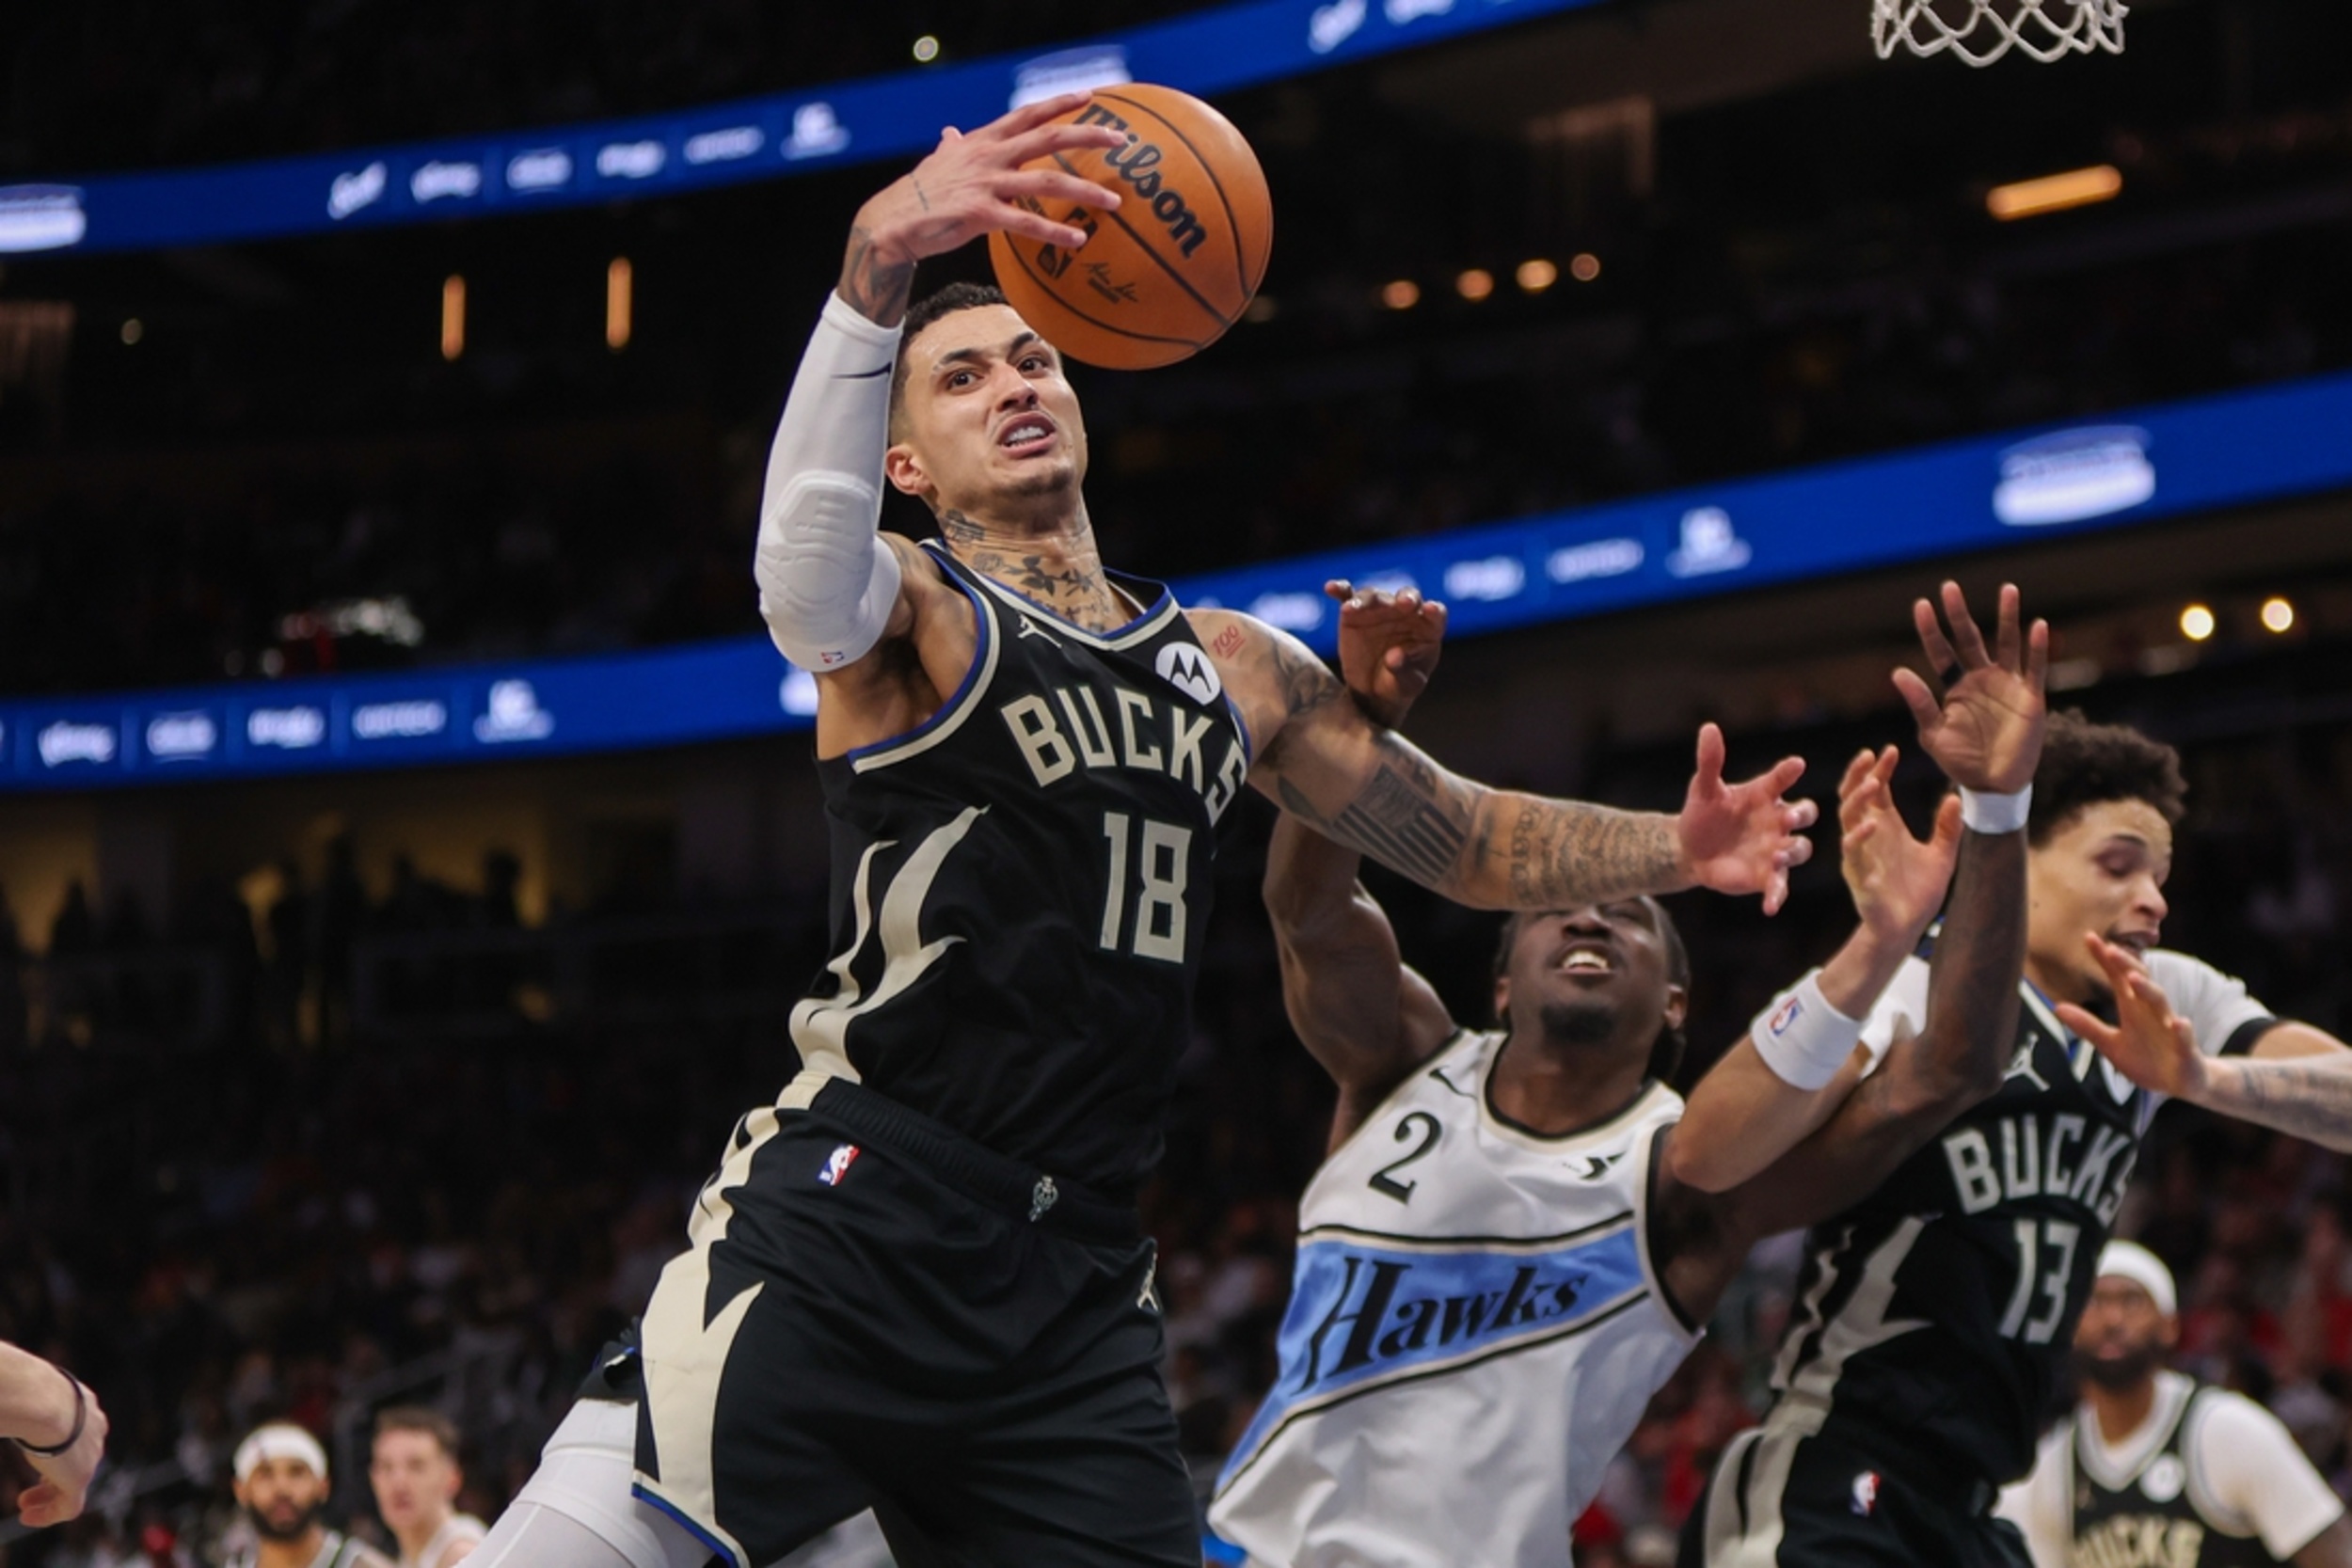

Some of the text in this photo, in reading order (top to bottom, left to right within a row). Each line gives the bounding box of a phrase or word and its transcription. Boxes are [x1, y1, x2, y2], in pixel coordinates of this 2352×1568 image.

[1000, 685, 1248, 829] BUCKS
[1099, 811, 1193, 964] 18
[1367, 1110, 1443, 1206] 2
[1290, 1256, 1589, 1398] Hawks
[1998, 1219, 2080, 1343] 13
